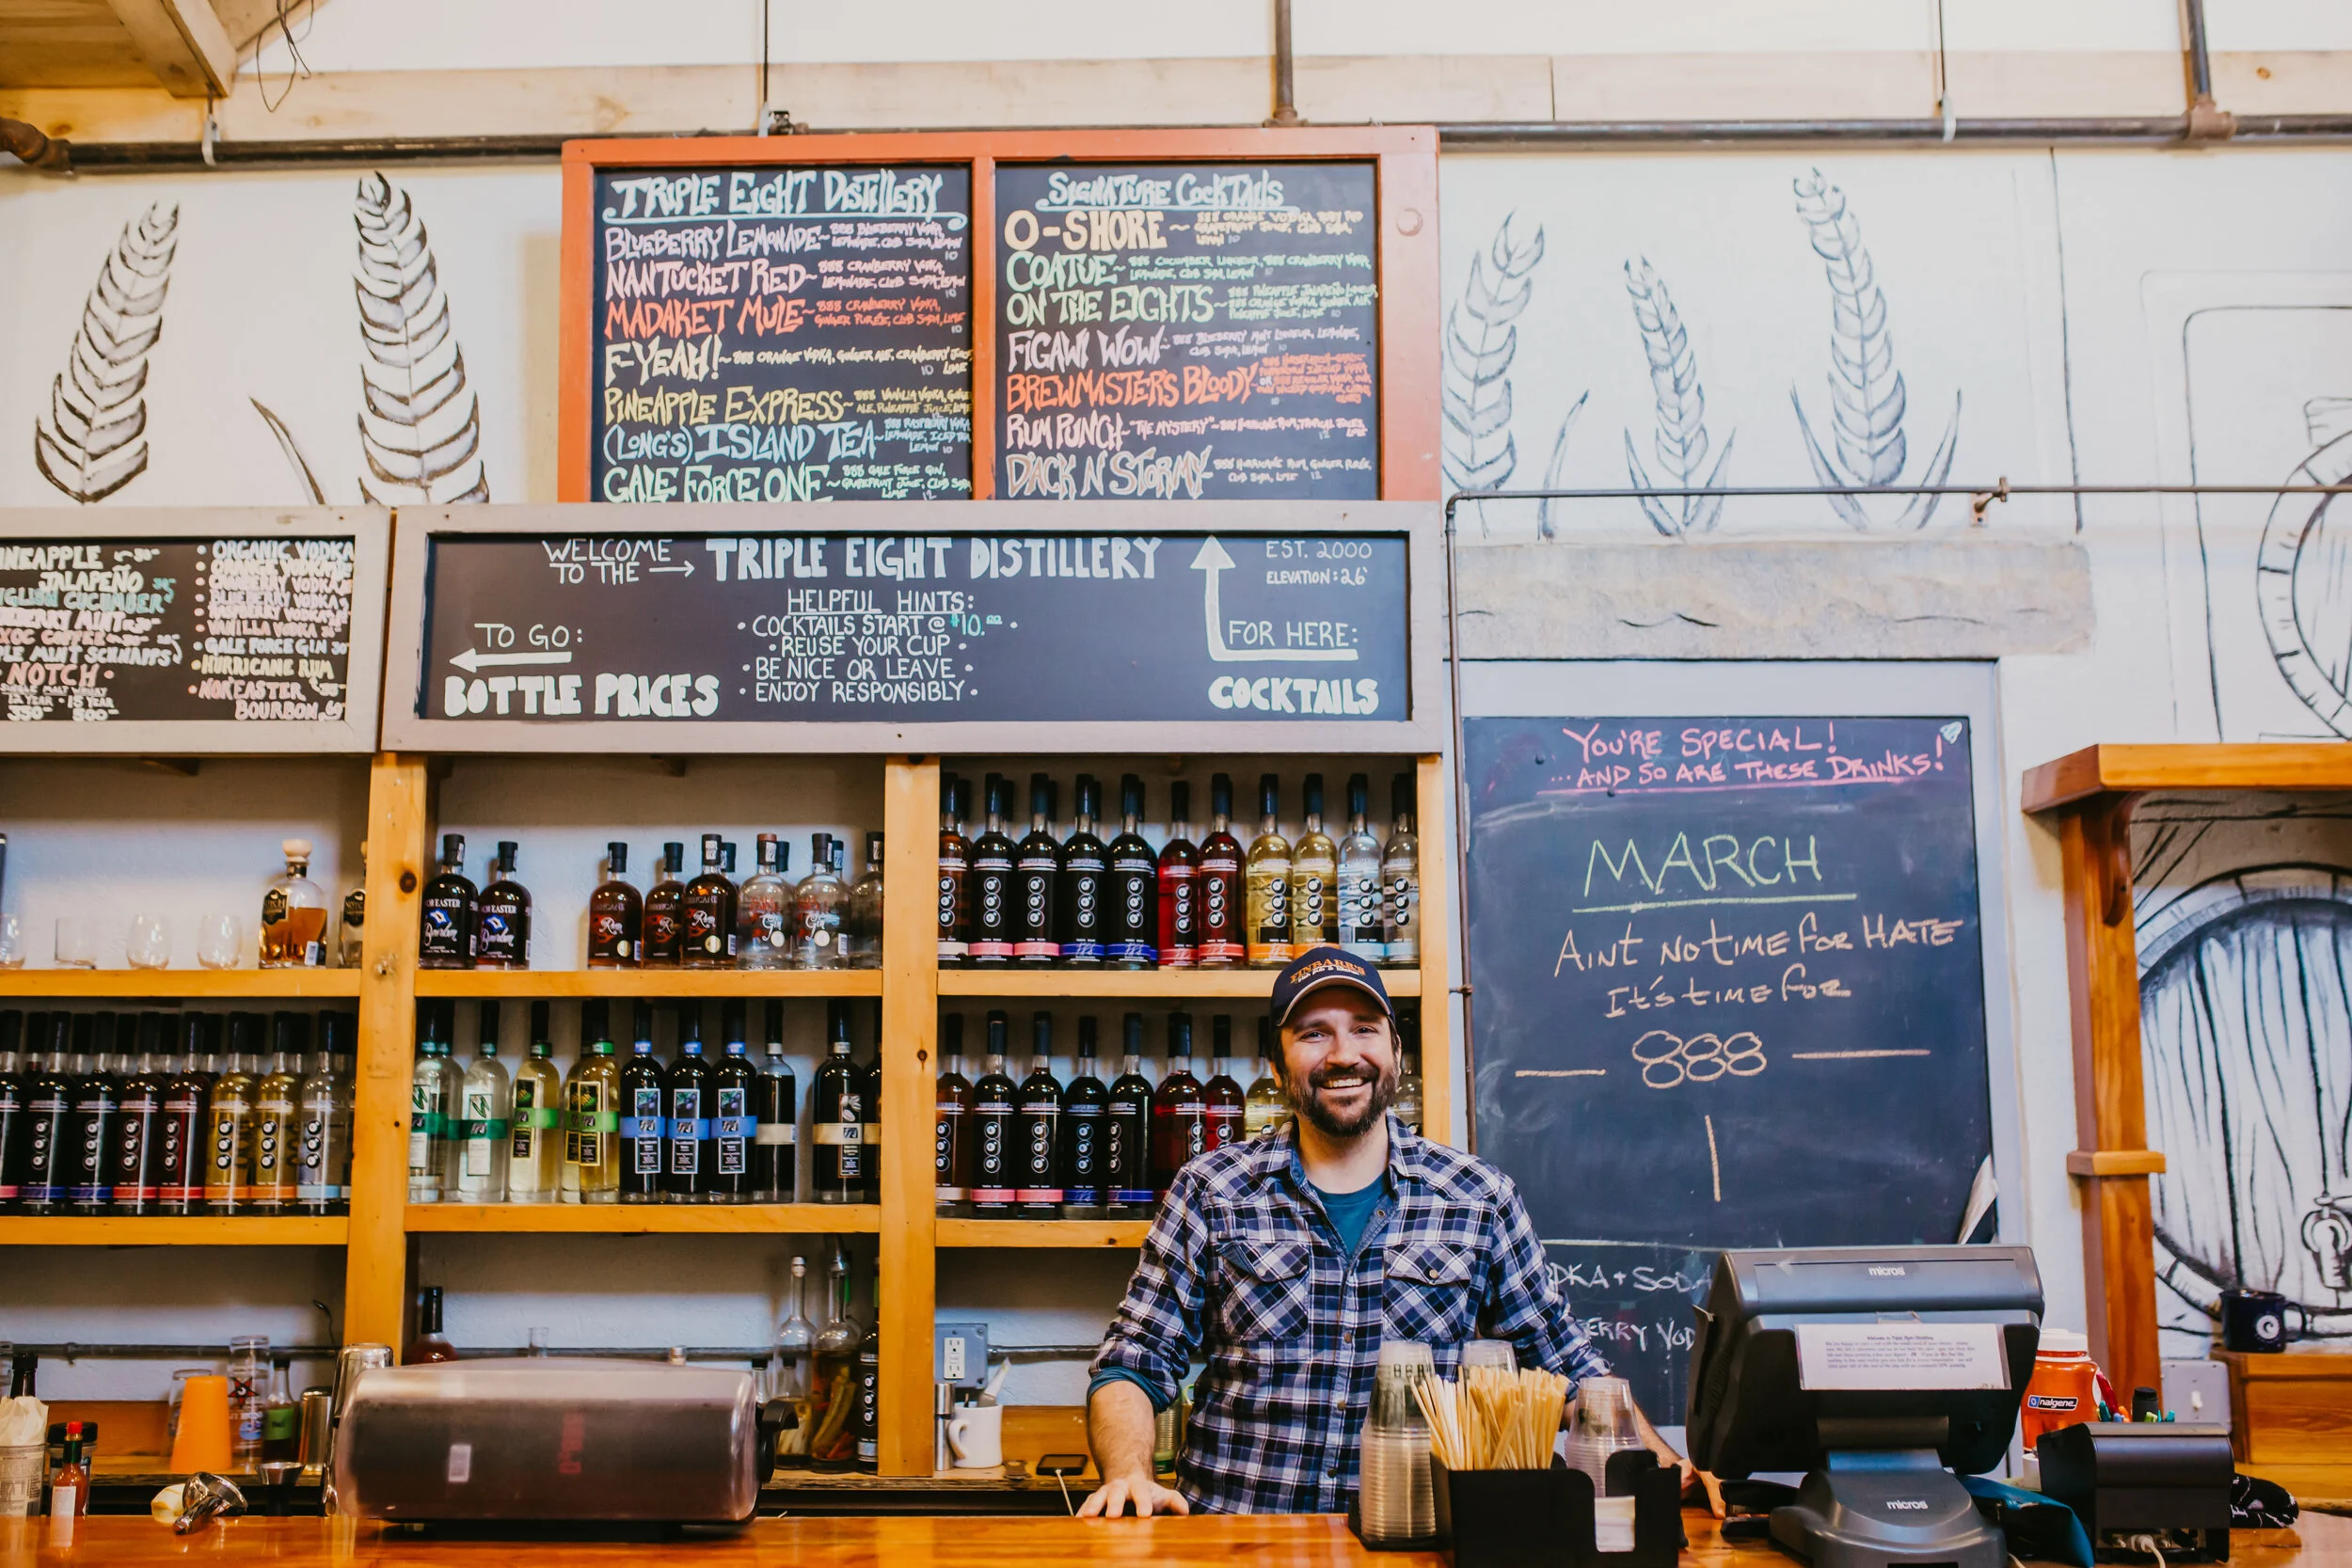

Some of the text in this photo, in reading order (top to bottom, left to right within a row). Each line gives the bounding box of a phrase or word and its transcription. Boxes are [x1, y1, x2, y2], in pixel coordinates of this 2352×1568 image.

[611, 168, 945, 223] TRIPLE EIGHT DISTILLERY
[1048, 169, 1285, 210] SIGNATURE COCKTAILS
[605, 219, 823, 263] BLUEBERRY LEMONADE
[945, 251, 959, 261] 10
[606, 258, 807, 302] NANTUCKET RED
[1006, 250, 1119, 293] COATUE
[945, 289, 957, 298] 10
[1007, 284, 1215, 328] ON THE EIGHTS
[604, 294, 806, 341] MADAKET MULE
[951, 325, 963, 334] 10
[921, 364, 934, 376] 10
[1183, 364, 1260, 405] BLOODY
[604, 385, 845, 426] PINEAPPLE EXPRESS
[603, 420, 877, 467] (LONG'S) ISLAND TEA
[1006, 410, 1124, 452] RUM PUNCH
[910, 441, 940, 454] LEMON
[604, 462, 834, 504] GALE FORCE ONE
[1080, 449, 1108, 497] N
[1109, 446, 1212, 499] STORMY
[213, 540, 355, 562] ORGANIC VODKA
[542, 539, 673, 563] WELCOME
[706, 535, 1163, 582] TRIPLE EIGHT DISTILLERY
[1264, 540, 1373, 561] EST. 2000
[549, 561, 641, 586] TO THE
[1266, 570, 1337, 586] ELEVATION:
[787, 588, 975, 615] HELPFUL HINTS:
[207, 619, 319, 639] VANILLA VODKA
[474, 623, 583, 651] TO GO:
[752, 615, 857, 643] COCKTAILS
[861, 616, 925, 642] START
[928, 618, 948, 641] @
[1229, 620, 1359, 647] FOR HERE:
[204, 636, 328, 657] GALE FORCE GIN
[780, 634, 951, 657] REUSE YOUR CUP
[7, 661, 101, 688] NOTCH
[201, 654, 335, 680] HURRICANE RUM
[755, 657, 957, 682] BE NICE OR LEAVE
[27, 696, 55, 708] YEAR
[86, 695, 116, 710] YEAR
[444, 672, 721, 718] BOTTLE PRICES
[755, 679, 965, 705] ENJOY RESPONSIBLY
[1208, 676, 1380, 715] COCKTAILS
[235, 700, 319, 721] BOURBON
[1563, 721, 1838, 763] YOU'RE SPECIAL!
[1638, 765, 1668, 785] SO
[1676, 764, 1729, 783] ARE
[1735, 760, 1819, 781] THESE
[1826, 734, 1946, 782] DRINKS!
[1584, 832, 1823, 897] MARCH
[1661, 934, 1700, 967] NO
[1862, 913, 1963, 949] HATE
[1632, 1029, 1767, 1089] 888
[1544, 1260, 1610, 1290] DKA
[1868, 1266, 1906, 1276] micros
[1581, 1316, 1696, 1352] ERRY VOD
[2040, 1399, 2075, 1409] nalgene
[1886, 1500, 1929, 1510] micros
